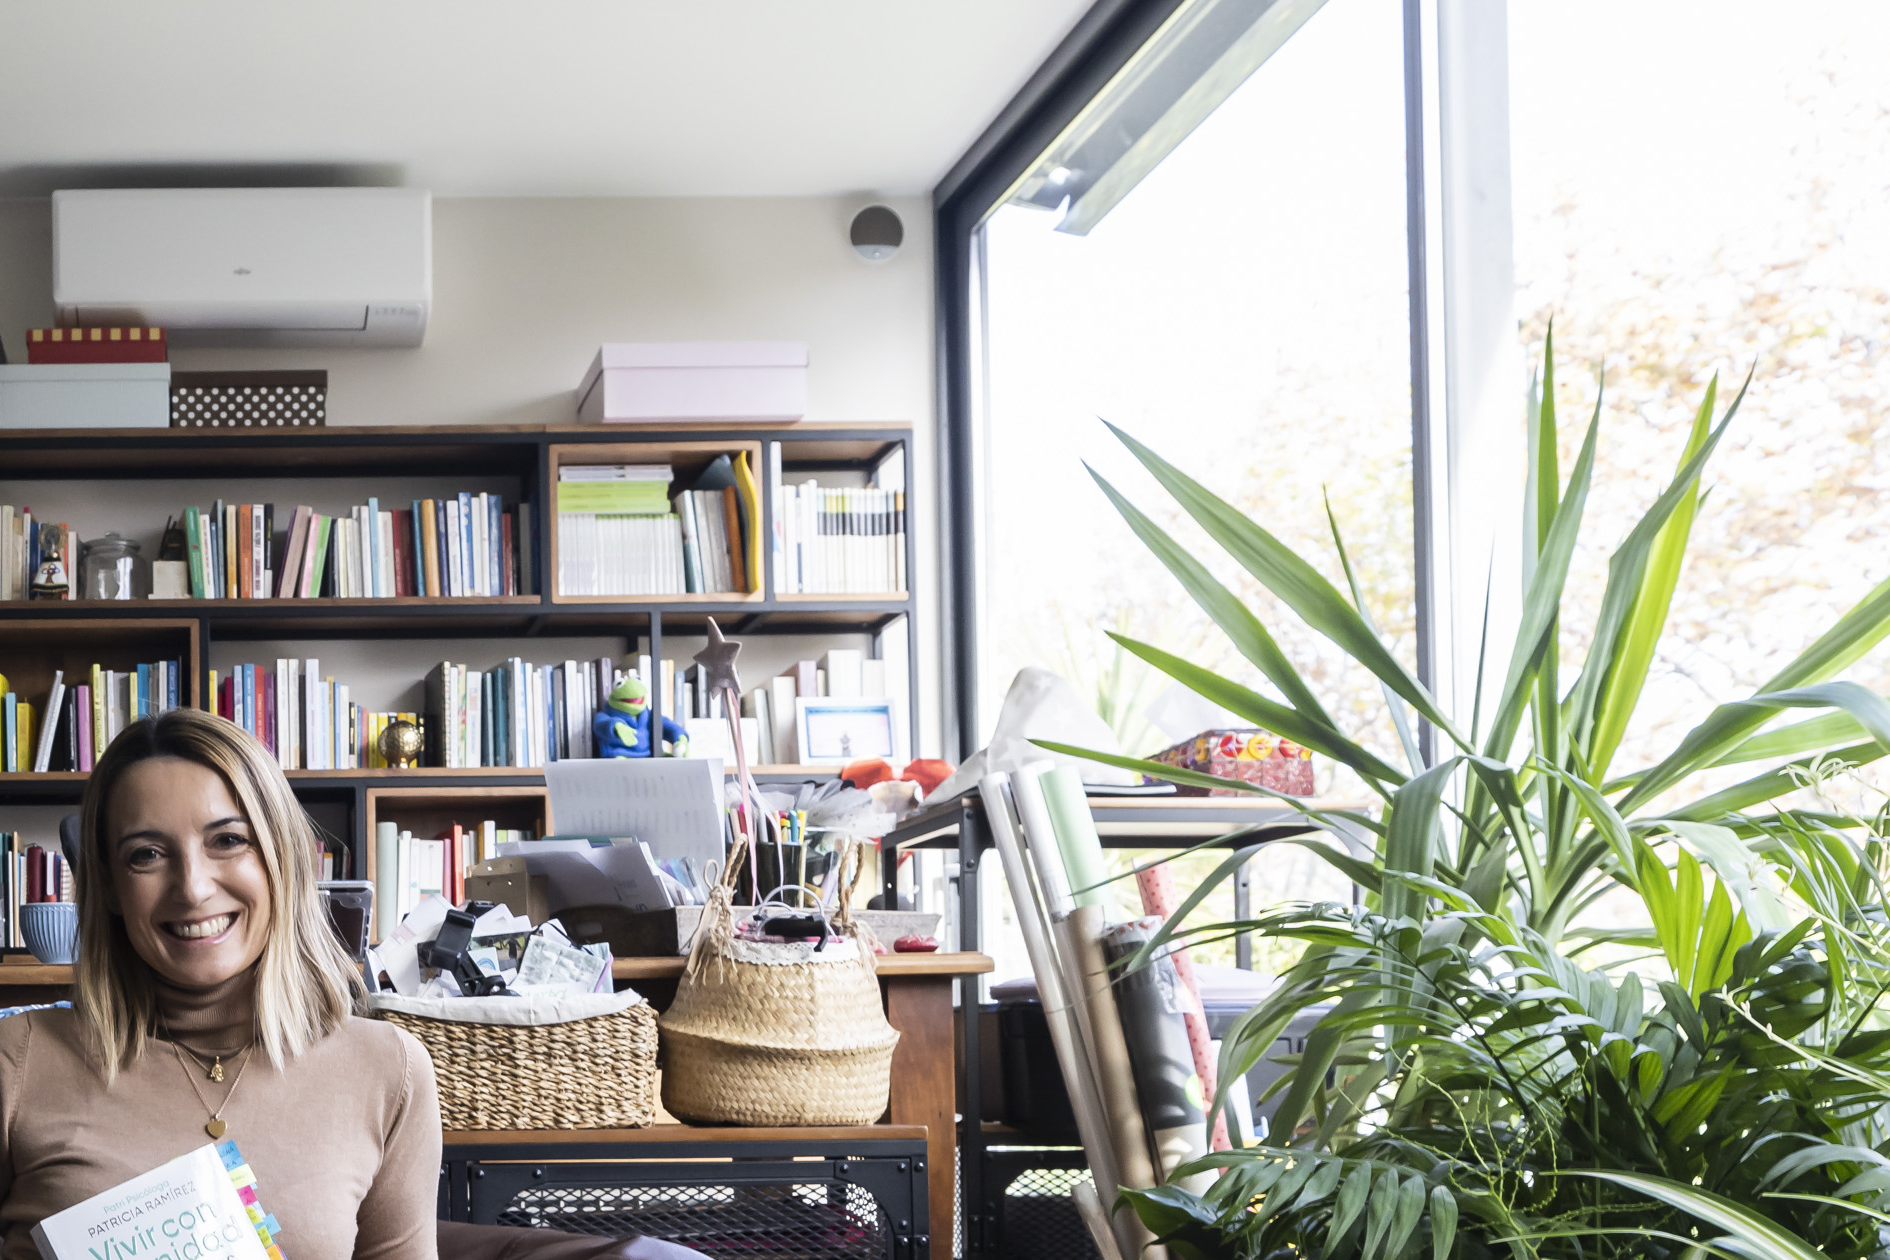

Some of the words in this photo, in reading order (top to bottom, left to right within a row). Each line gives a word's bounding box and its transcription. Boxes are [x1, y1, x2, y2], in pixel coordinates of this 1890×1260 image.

[87, 1207, 145, 1239] PATRICIA
[145, 1180, 197, 1212] RAMÍREZ
[103, 1200, 125, 1215] Patri
[126, 1178, 170, 1206] Psicóloga
[161, 1202, 217, 1238] con
